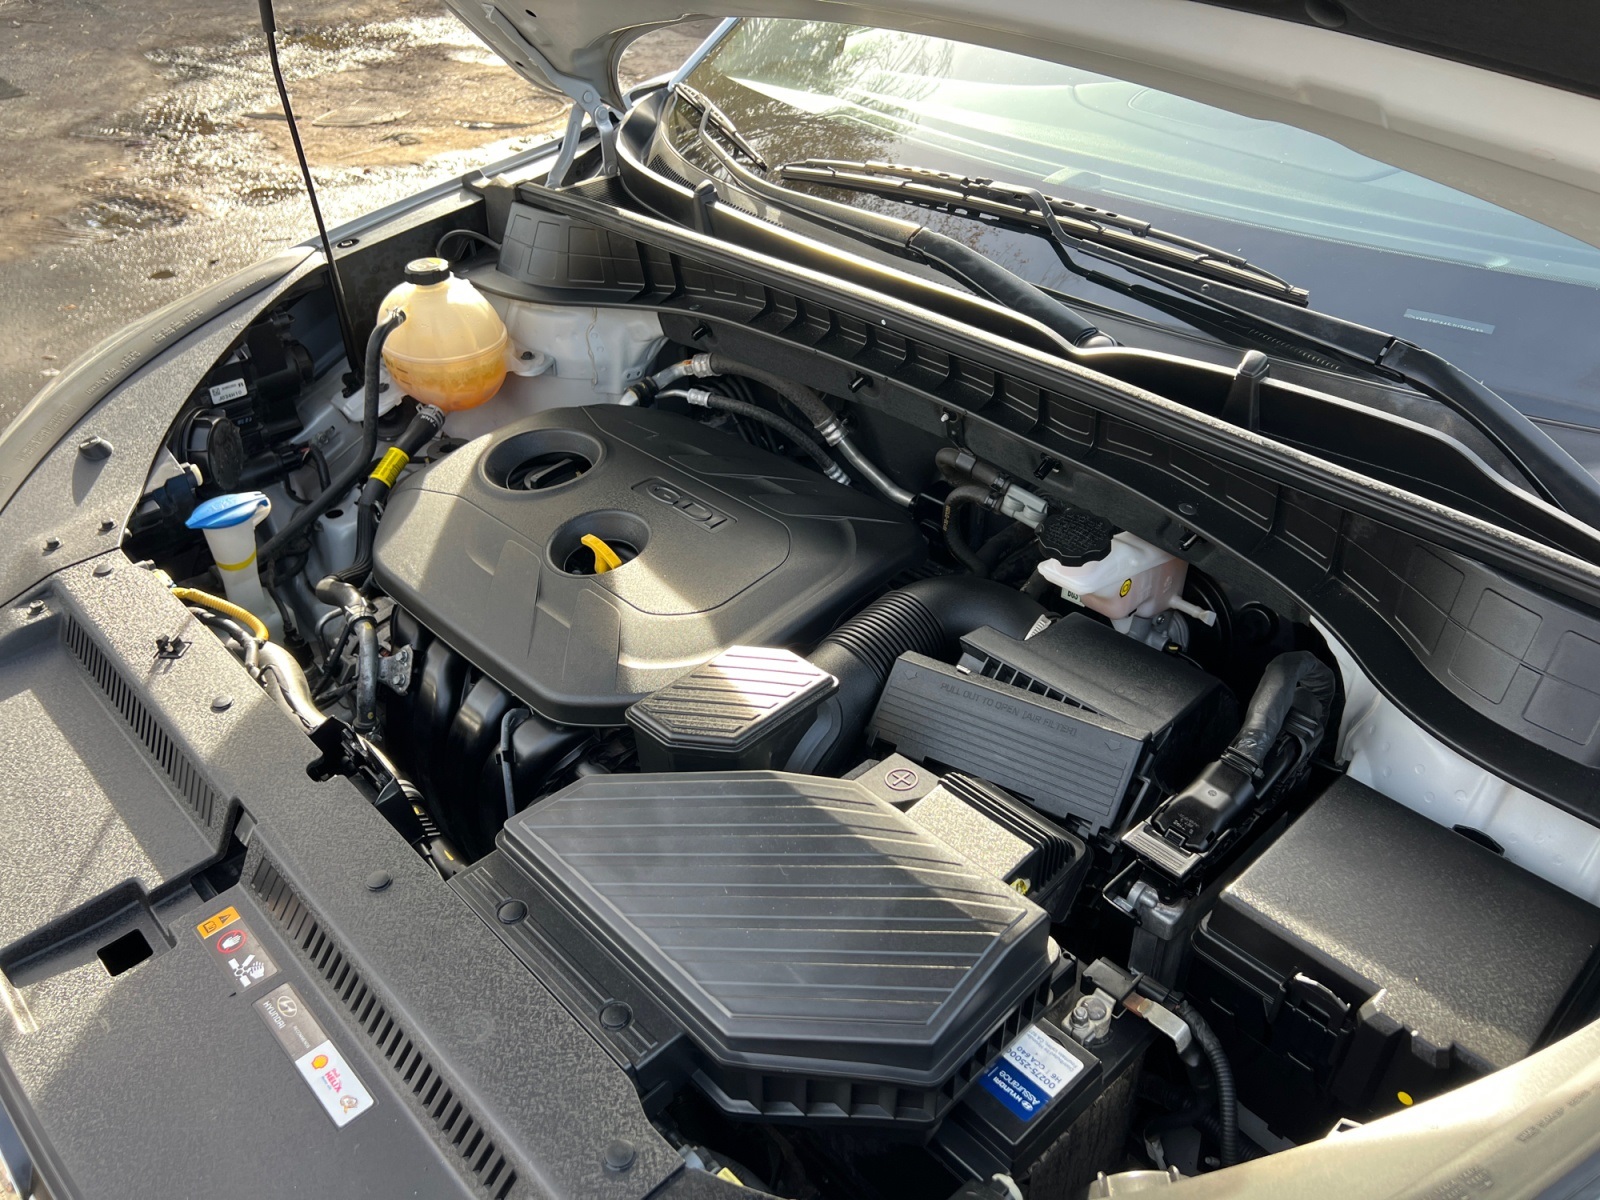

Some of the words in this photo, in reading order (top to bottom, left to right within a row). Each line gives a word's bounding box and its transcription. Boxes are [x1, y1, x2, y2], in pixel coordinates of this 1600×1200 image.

[646, 484, 728, 530] GDI
[940, 682, 961, 696] PULL
[963, 689, 980, 702] OUT
[982, 695, 995, 707] TO
[995, 700, 1019, 716] OPEN
[263, 1000, 286, 1029] HYUNDAI
[1016, 1045, 1031, 1058] 640
[1030, 1056, 1046, 1070] CCA
[325, 1071, 343, 1093] HELIX
[992, 1076, 1023, 1103] HYUNDAI
[998, 1069, 1041, 1106] Assurance
[1049, 1072, 1062, 1084] H6
